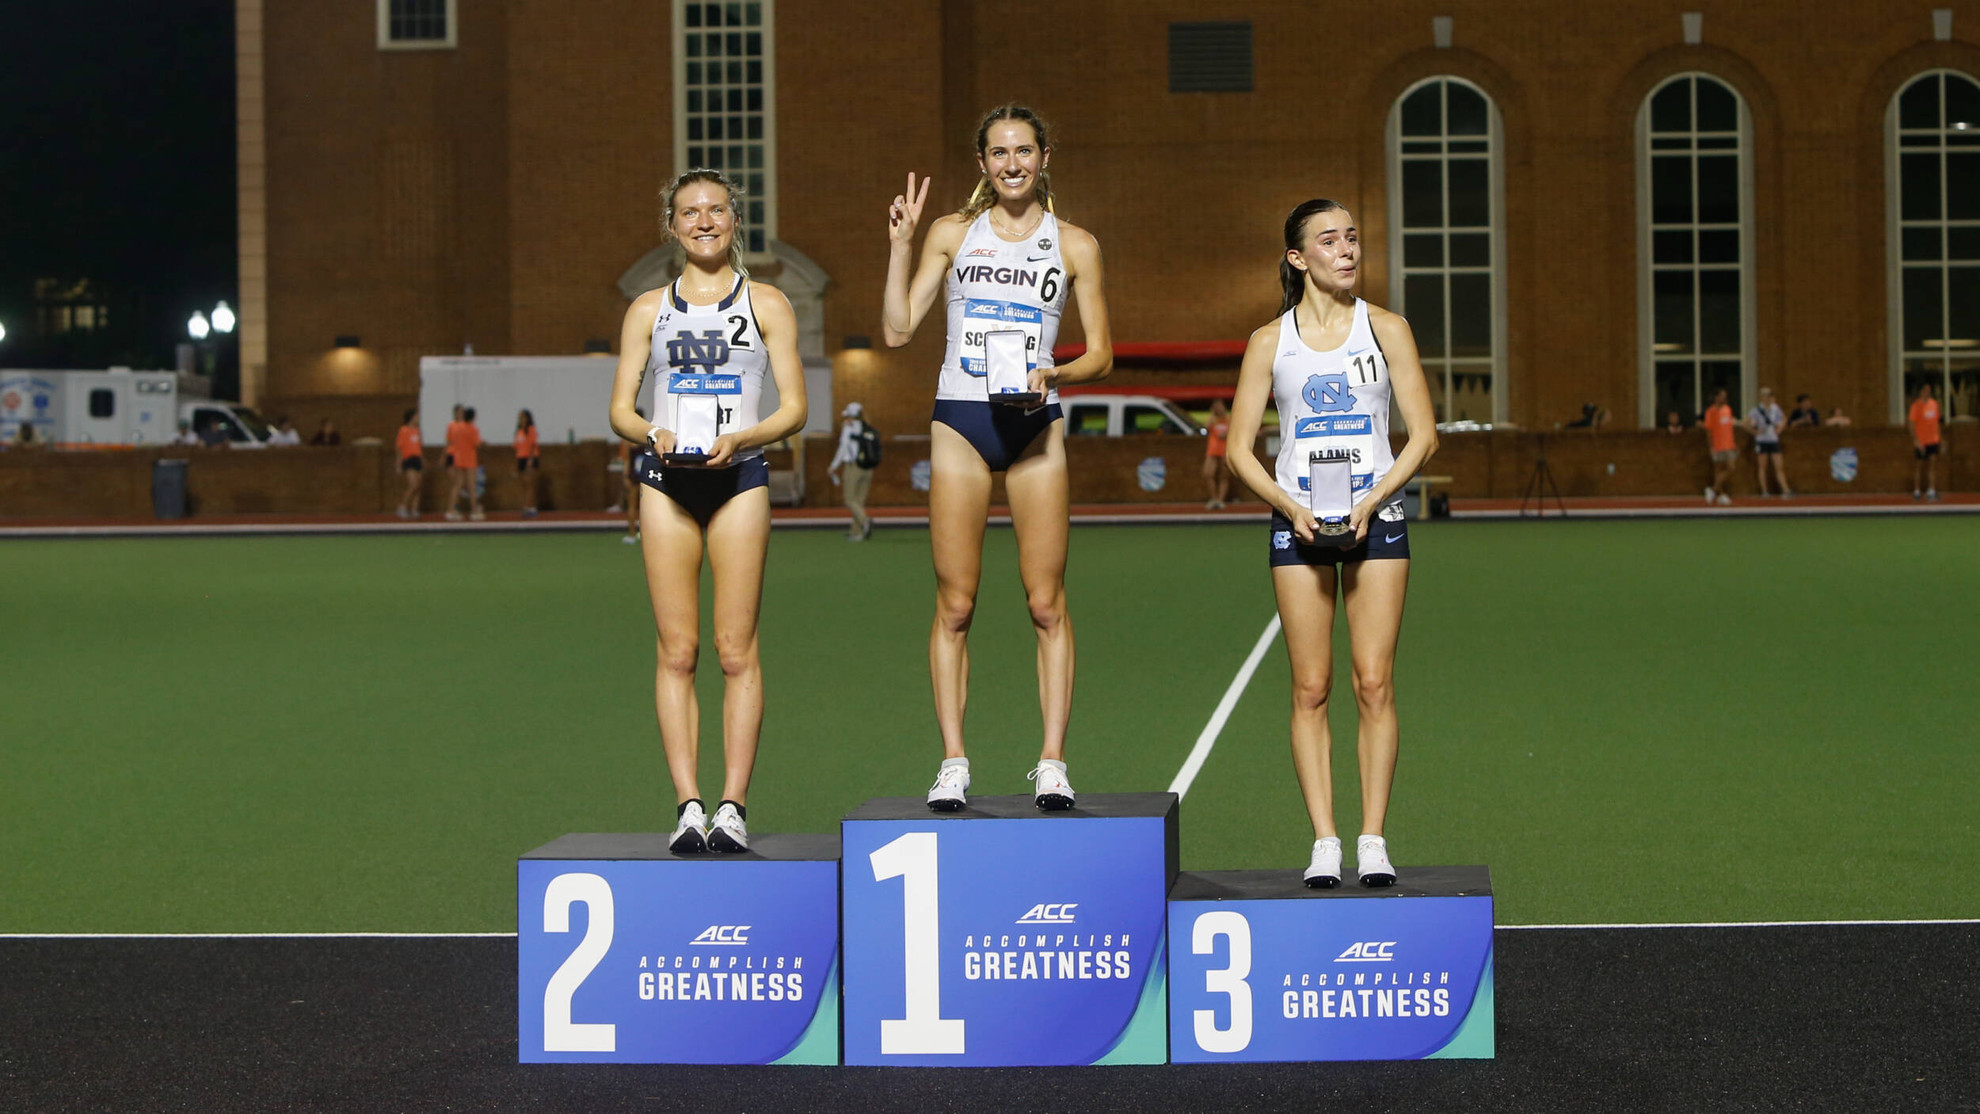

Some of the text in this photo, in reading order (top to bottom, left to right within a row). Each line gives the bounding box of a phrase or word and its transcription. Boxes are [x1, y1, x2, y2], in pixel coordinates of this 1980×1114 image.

[965, 249, 998, 258] ACC
[1040, 267, 1061, 302] 6
[970, 304, 1000, 315] ACC
[728, 315, 750, 347] 2
[1352, 355, 1377, 383] 11
[673, 379, 700, 389] ACC
[1300, 421, 1328, 433] ACC
[1016, 904, 1078, 923] ACC
[690, 926, 751, 945] ACC
[869, 832, 965, 1054] 1
[966, 935, 1129, 947] ACCOMPLISH
[544, 873, 615, 1051] 2
[1334, 942, 1396, 962] ACC
[640, 957, 801, 968] ACCOMPLISH
[965, 951, 1129, 979] GREATNESS
[639, 973, 802, 1000] GREATNESS
[1193, 912, 1252, 1052] 3
[1284, 973, 1448, 986] ACCOMPLISH
[1284, 989, 1448, 1018] GREATNESS
